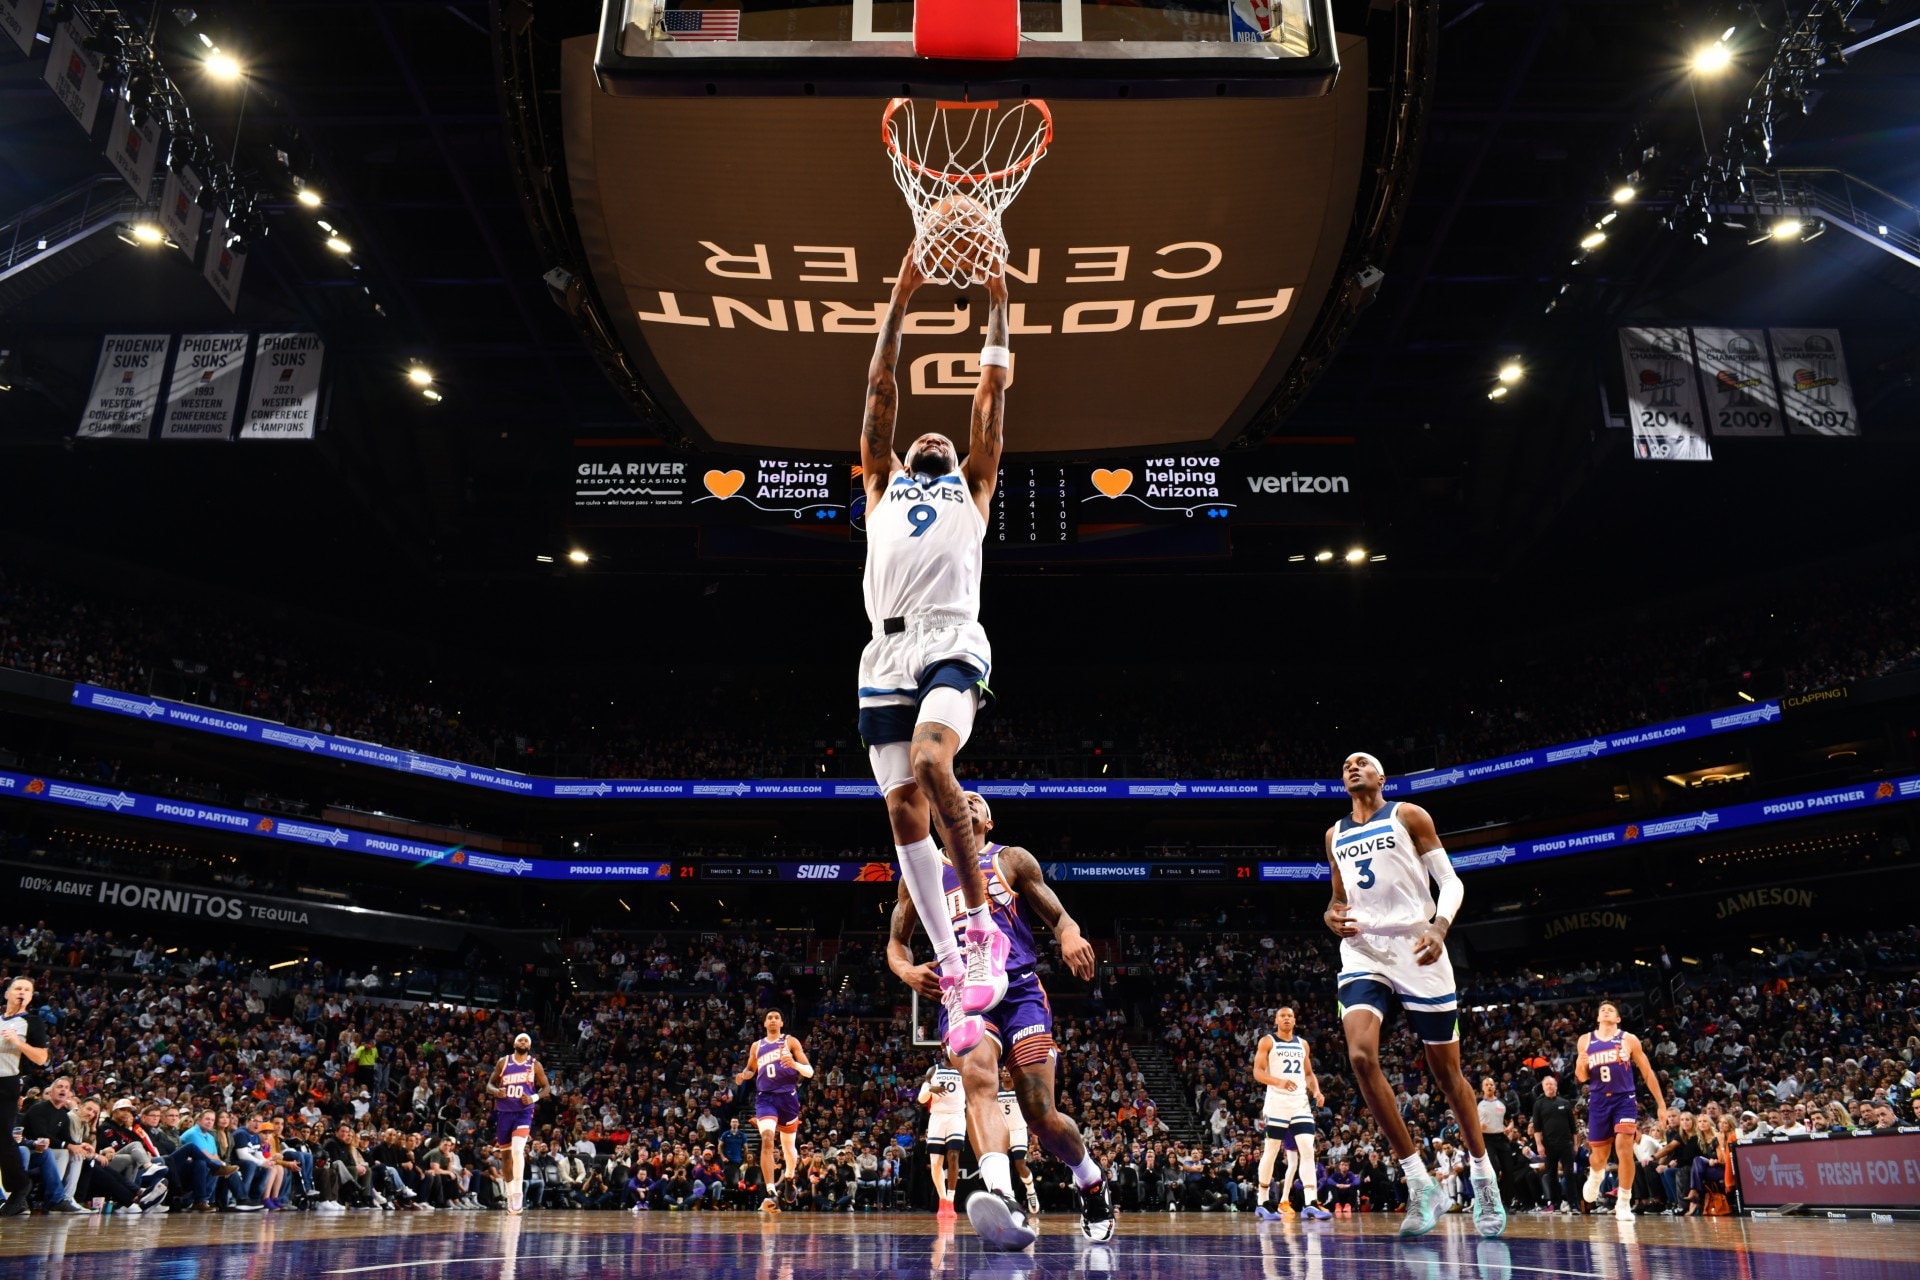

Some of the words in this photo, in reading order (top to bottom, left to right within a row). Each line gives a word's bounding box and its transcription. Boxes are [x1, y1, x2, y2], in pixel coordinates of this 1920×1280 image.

[1237, 32, 1257, 42] NBA
[638, 287, 1294, 334] FOOTPRINT
[106, 339, 165, 352] PHOENIX
[183, 338, 242, 352] PHOENIX
[263, 338, 320, 350] PHOENIX
[114, 355, 149, 368] SUNS
[192, 355, 227, 368] SUNS
[272, 353, 306, 366] SUNS
[1630, 353, 1684, 361] CHAMPIONS
[115, 387, 134, 396] 1976
[195, 387, 214, 396] 1993
[274, 386, 294, 394] 2021
[100, 399, 142, 408] WESTERN
[181, 399, 222, 408] WESTERN
[262, 398, 302, 407] WESTERN
[171, 412, 228, 420] CONFERENCE
[251, 410, 308, 420] CONFERENCE
[1641, 412, 1693, 428] 2014
[1719, 412, 1772, 428] 2009
[1796, 412, 1848, 427] 2007
[89, 423, 141, 433] CHAMPIONS
[171, 424, 222, 433] CHAMPIONS
[252, 422, 303, 432] CHAMPIONS
[1146, 457, 1175, 467] We
[1181, 456, 1220, 467] love
[578, 463, 622, 475] GILA
[627, 463, 684, 475] RIVER
[1030, 468, 1034, 476] 1
[1060, 468, 1064, 476] 1
[758, 470, 827, 486] helping
[1059, 479, 1065, 487] 2
[1146, 469, 1216, 485] helping
[1247, 472, 1349, 493] verizon
[756, 485, 829, 498] Arizona
[891, 487, 964, 503] WOLVES
[1030, 490, 1035, 498] 2
[1060, 490, 1065, 498] 3
[1146, 484, 1218, 497] Arizona
[908, 504, 937, 537] 9
[1060, 511, 1066, 519] 0
[1030, 522, 1035, 530] 1
[1060, 522, 1066, 530] 0
[1788, 688, 1841, 707] CLAPPING
[170, 710, 248, 732] WWW.ASEI.COM
[1612, 726, 1686, 747] WWW.ASEI.COM
[330, 742, 398, 763] WWW.ASEI.COM
[1468, 756, 1534, 777] WWW.ASEI.COM
[470, 771, 533, 791] WWW.ASEI.COM
[1763, 800, 1804, 815] PROUD
[1807, 790, 1865, 808] PARTNER
[156, 803, 195, 818] PROUD
[198, 810, 248, 827] PARTNER
[1336, 836, 1395, 862] WOLVES
[1532, 840, 1566, 853] PROUD
[1568, 832, 1615, 848] PARTNER
[366, 839, 399, 852] PROUD
[401, 844, 444, 860] PARTNER
[570, 866, 602, 874] PROUD
[605, 866, 649, 874] PARTNER
[680, 866, 694, 877] 21
[797, 865, 840, 879] SUNS
[1072, 867, 1146, 876] TIMBERWOLVES
[1236, 866, 1251, 878] 21
[1355, 858, 1375, 889] 3
[20, 876, 52, 892] 100%
[54, 882, 94, 897] AGAVE
[98, 882, 243, 919] HORNITOS
[249, 905, 308, 924] TEQUILA
[1715, 888, 1814, 919] JAMESON
[1543, 911, 1628, 941] JAMESON
[1012, 1024, 1045, 1044] PHOENIX
[757, 1048, 780, 1068] SUNS
[1588, 1049, 1617, 1070] SUNS
[766, 1064, 776, 1078] 0
[1283, 1059, 1301, 1073] 22
[503, 1072, 527, 1085] SUNS
[1600, 1065, 1611, 1082] 8
[507, 1085, 523, 1098] 00
[1005, 1105, 1011, 1115] 5
[1768, 1154, 1804, 1189] fry's
[1816, 1162, 1863, 1186] FRESH
[1866, 1160, 1901, 1185] FOR
